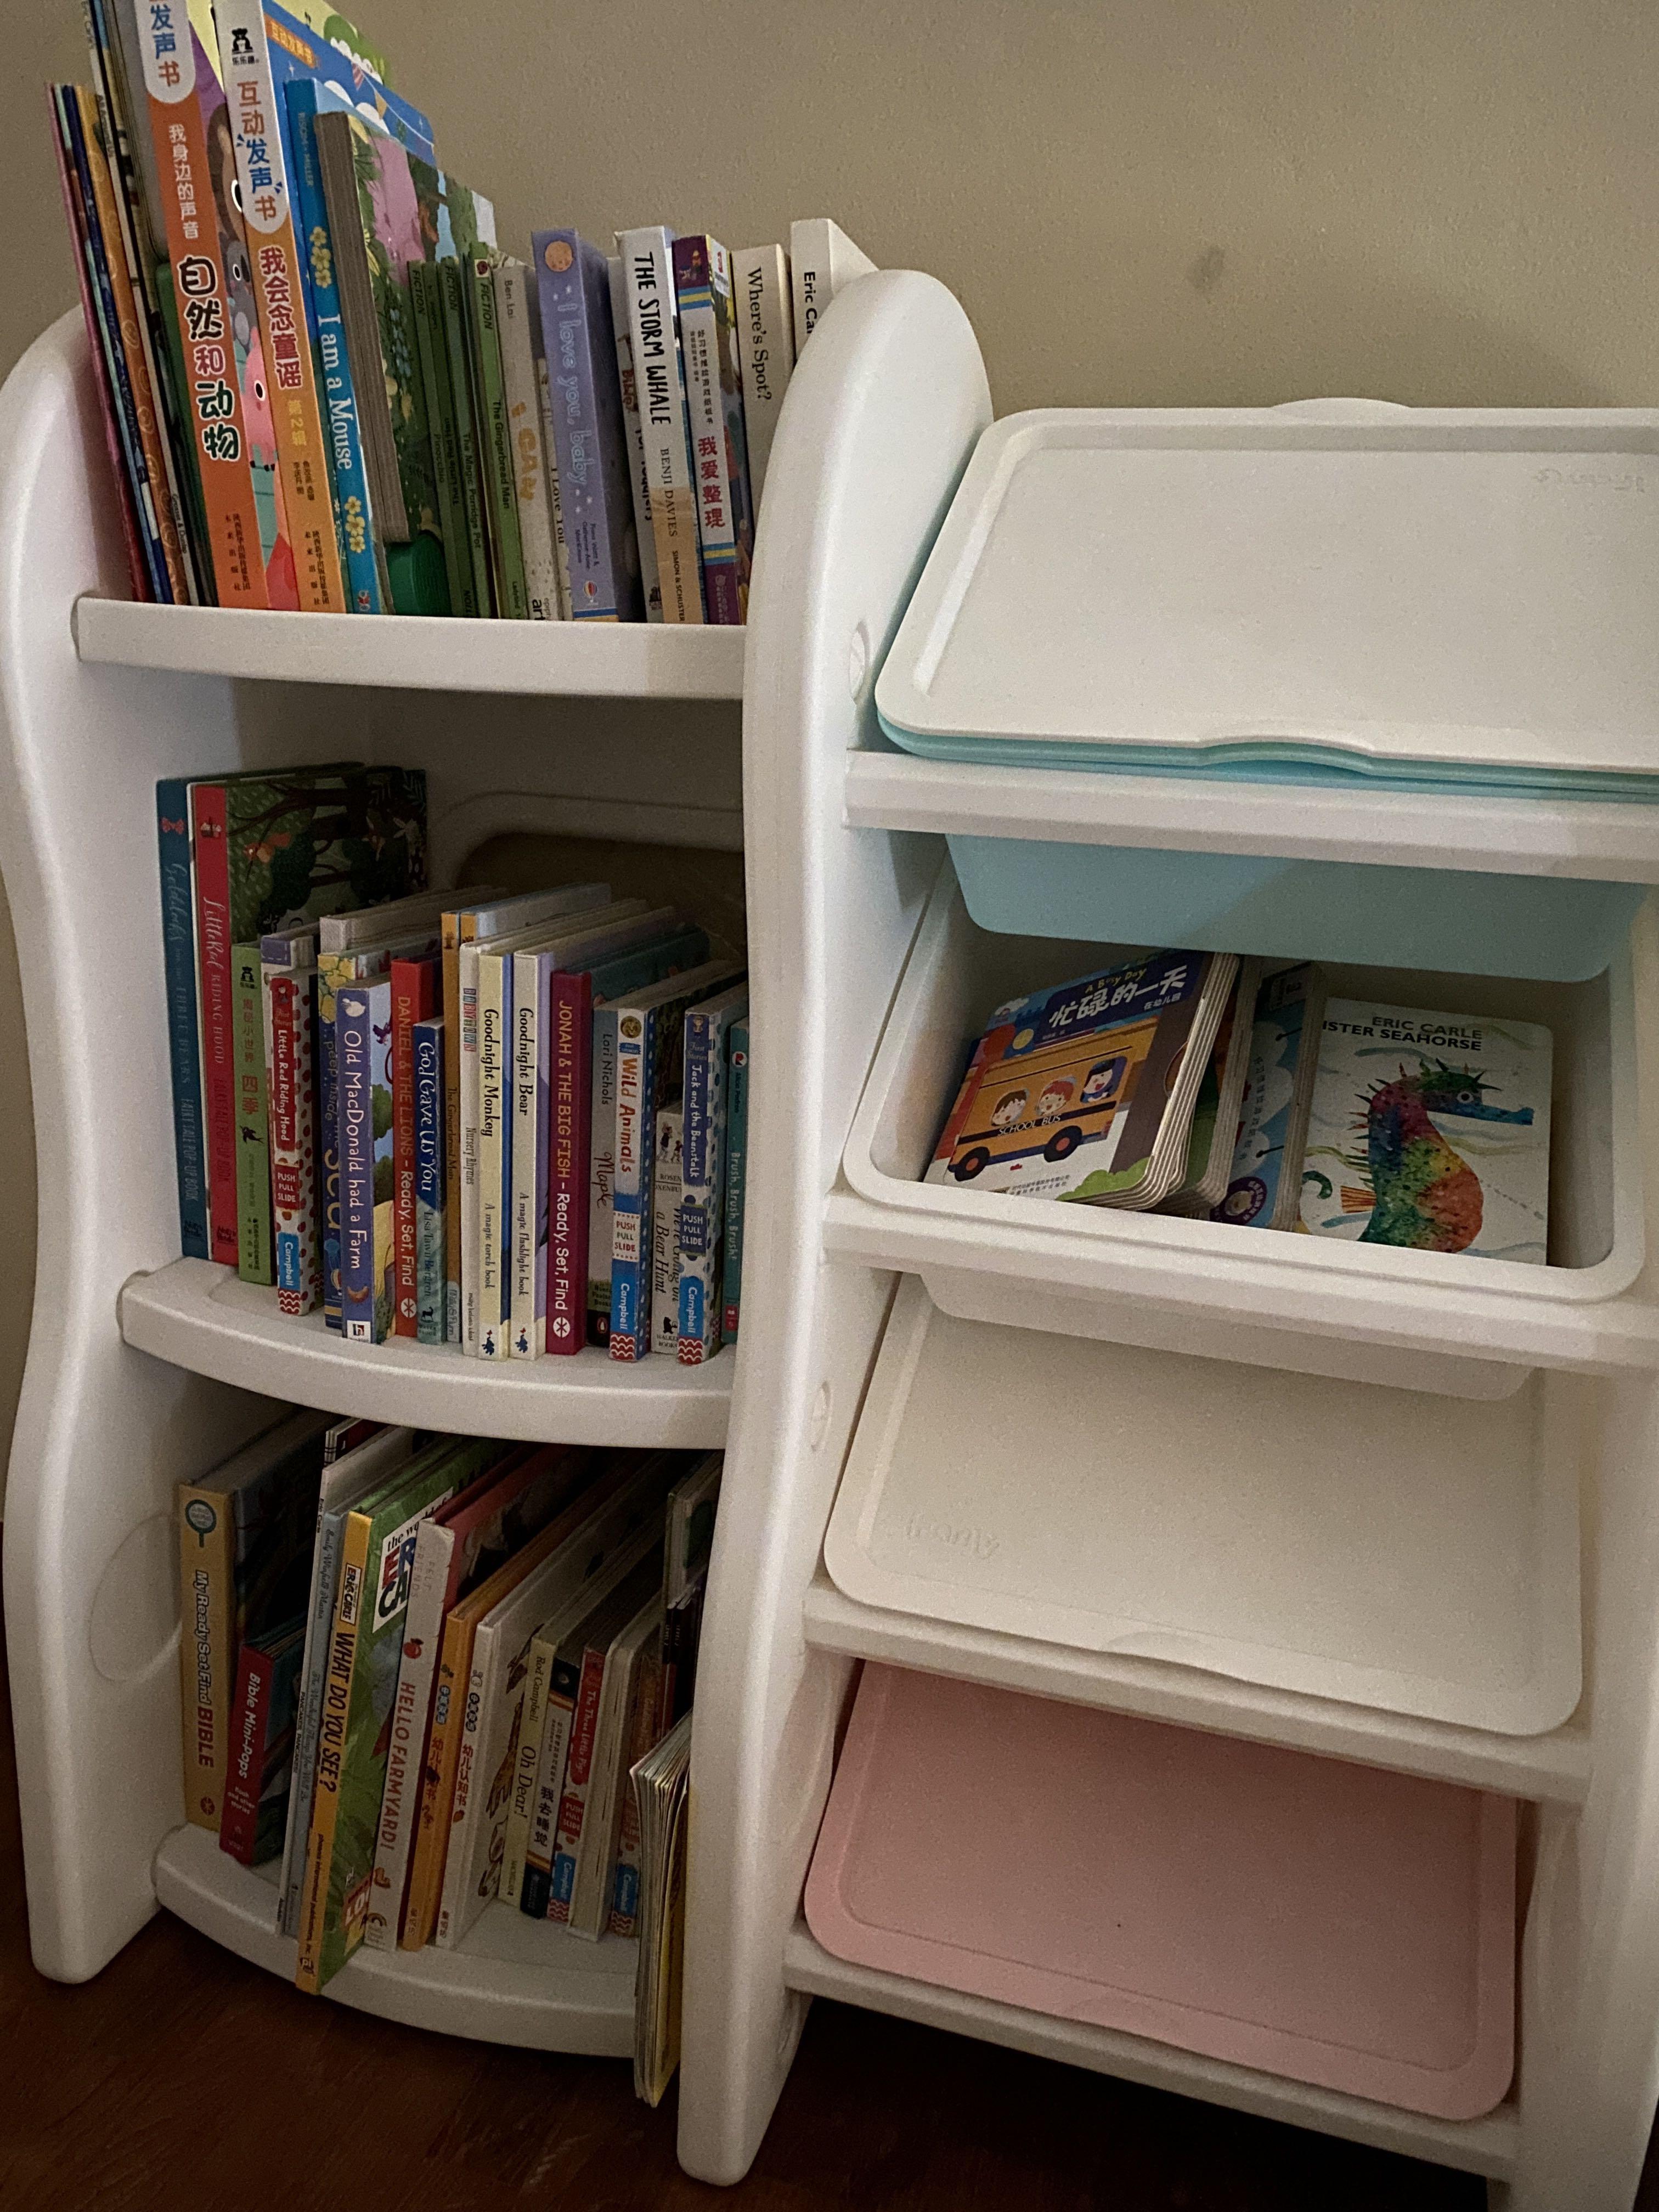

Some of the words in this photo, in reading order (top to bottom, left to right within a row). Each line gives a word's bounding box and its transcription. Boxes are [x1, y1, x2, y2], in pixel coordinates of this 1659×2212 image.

[236, 80, 277, 221] 互动发声书
[168, 123, 199, 239] 我身边的声音
[634, 251, 657, 291] THE
[803, 272, 816, 303] Eric
[411, 269, 426, 315] FICTION
[445, 265, 458, 312] FICTION
[479, 281, 493, 330] FICTION
[504, 280, 514, 300] Ben
[747, 266, 768, 345] Where's
[258, 244, 302, 388] 我会念童谣
[318, 314, 341, 328] I
[638, 299, 665, 358] STORM
[177, 253, 241, 461] 自然和动物
[319, 332, 340, 372] am
[559, 319, 582, 370] love
[326, 376, 341, 390] a
[753, 349, 772, 401] Spot?
[493, 401, 501, 419] The
[556, 376, 582, 426] you,
[645, 365, 672, 425] WHALE
[329, 397, 354, 471] Mouse
[433, 433, 445, 483] Pinocchio
[464, 453, 474, 486] Magic
[495, 422, 509, 487] Gingerbread
[567, 430, 592, 485] baby
[659, 447, 673, 485] BENJI
[500, 487, 510, 509] Man
[697, 436, 726, 528] 我爱整理
[467, 487, 479, 529] Porridge
[664, 489, 679, 538] DAVIES
[473, 535, 481, 549] Pot
[672, 550, 681, 575] SIMON
[676, 585, 686, 622] SCHUSTER
[1048, 964, 1188, 1029] 忙碌的一天
[1084, 984, 1094, 994] A
[1097, 976, 1122, 989] Busy
[1124, 967, 1148, 981] Day
[1143, 992, 1182, 1011] 在幼儿园
[397, 996, 413, 1056] DANIEL
[462, 988, 477, 1052] BABYTOWN
[558, 1000, 573, 1055] JONAH
[1372, 1015, 1414, 1031] ERIC
[1420, 1023, 1483, 1041] CARLE
[277, 1029, 290, 1059] Little
[343, 1030, 363, 1065] Old
[418, 1041, 435, 1073] God
[480, 1007, 501, 1080] Goodnight
[515, 1007, 535, 1079] Goodnight
[602, 1033, 614, 1057] Lori
[1380, 1028, 1482, 1052] SEAHORSE
[279, 1060, 289, 1078] Red
[397, 1058, 411, 1070] &
[558, 1058, 572, 1068] &
[620, 1057, 639, 1098] Wild
[691, 1064, 702, 1088] Jack
[241, 1075, 258, 1115] 四季
[276, 1079, 290, 1115] Riding
[398, 1074, 413, 1104] THE
[558, 1073, 572, 1102] THE
[601, 1059, 614, 1105] Nichols
[419, 1080, 435, 1127] Gave
[479, 1085, 500, 1138] Monkey
[518, 1083, 534, 1116] Bear
[690, 1090, 701, 1109] and
[280, 1116, 290, 1142] Hood
[345, 1071, 365, 1173] MacDonald
[557, 1104, 572, 1136] BIG
[690, 1110, 701, 1128] the
[996, 1119, 1036, 1138] SCHOOL
[1041, 1114, 1062, 1127] BUS
[420, 1128, 435, 1156] Us
[462, 1127, 477, 1157] Nursery
[619, 1102, 637, 1173] Animals
[689, 1128, 702, 1178] Beanstalk
[462, 1158, 477, 1185] Rhymes
[557, 1139, 572, 1178] FISH
[730, 1151, 741, 1185] Brush,
[277, 1172, 297, 1184] PUSH
[278, 1183, 295, 1194] PULL
[421, 1159, 436, 1193] You
[591, 1152, 615, 1208] Maple
[659, 1173, 681, 1182] ROSEN
[277, 1192, 297, 1204] SLIDE
[348, 1180, 366, 1210] had
[398, 1170, 414, 1222] Ready,
[485, 1203, 495, 1211] A
[729, 1188, 741, 1223] Brush,
[351, 1215, 361, 1223] a
[423, 1211, 435, 1232] Lisa
[483, 1214, 496, 1242] magic
[517, 1202, 530, 1231] magic
[554, 1192, 571, 1244] Ready,
[616, 1221, 636, 1231] PUSH
[656, 1211, 665, 1221] a
[682, 1214, 703, 1225] PUSH
[683, 1224, 702, 1235] PULL
[349, 1228, 368, 1269] Farm
[423, 1232, 435, 1258] Tawn
[518, 1233, 531, 1274] flashlight
[614, 1242, 636, 1252] SLIDE
[617, 1232, 634, 1241] PULL
[656, 1224, 670, 1257] Bear
[681, 1234, 703, 1245] SLIDE
[727, 1225, 739, 1261] Brush!
[283, 1241, 296, 1288] Campbell
[400, 1256, 415, 1287] Find
[485, 1243, 496, 1268] torch
[422, 1260, 435, 1297] Bergren
[485, 1269, 496, 1289] book
[518, 1276, 529, 1296] book
[655, 1259, 669, 1294] Hunt
[555, 1279, 569, 1311] Find
[618, 1283, 630, 1330] Campbell
[687, 1285, 698, 1334] Campbell
[321, 1528, 334, 1553] Emily
[191, 1569, 209, 1595] My
[319, 1552, 334, 1590] Winfield
[343, 1566, 356, 1593] ERIC
[425, 1560, 436, 1591] FELT
[191, 1595, 210, 1641] Ready
[318, 1590, 330, 1620] Martin
[341, 1593, 354, 1620] CARLE
[196, 1644, 211, 1671] Set
[330, 1632, 356, 1684] WHAT
[535, 1656, 546, 1674] Rod
[197, 1671, 212, 1706] Find
[247, 1672, 261, 1708] Bible
[326, 1684, 348, 1711] DO
[529, 1678, 544, 1724] Campbell
[393, 1681, 415, 1742] HELLO
[198, 1706, 214, 1769] BIBLE
[237, 1708, 257, 1780] Mini-Pops
[323, 1713, 346, 1747] YOU
[579, 1733, 591, 1756] Little
[318, 1748, 341, 1793] SEE?
[519, 1745, 536, 1769] Oh
[456, 1745, 473, 1807] 幼儿认知书
[380, 1744, 407, 1850] FARMYARD!
[514, 1773, 532, 1819] Dear!
[565, 1802, 583, 1814] PUSH
[534, 1786, 554, 1847] 我去睡觉
[563, 1818, 580, 1830] SLIDE
